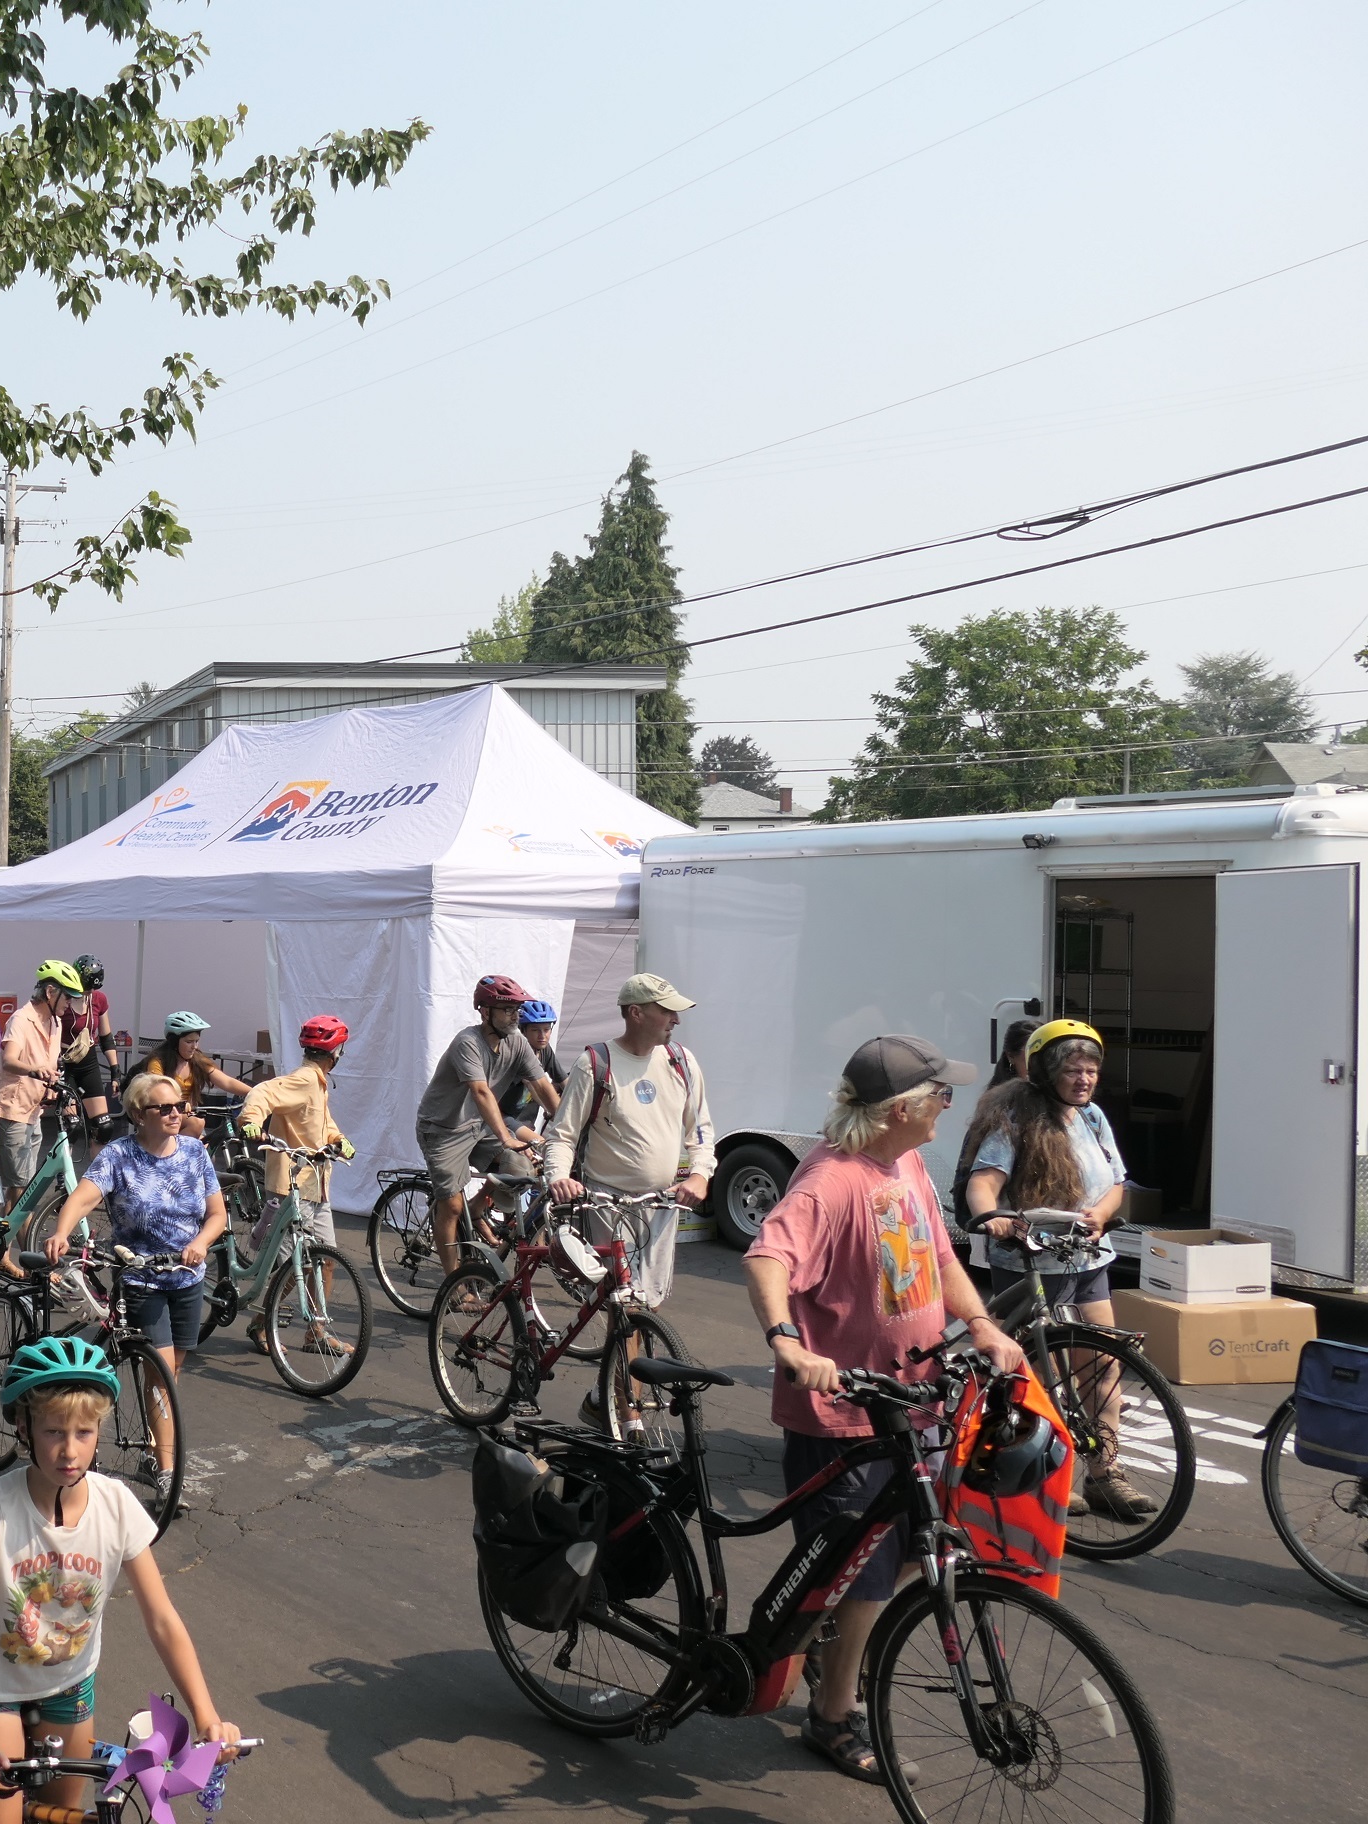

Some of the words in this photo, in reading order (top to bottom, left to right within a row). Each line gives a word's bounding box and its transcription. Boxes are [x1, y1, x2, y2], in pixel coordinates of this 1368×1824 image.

[303, 781, 439, 819] Benton
[144, 817, 212, 831] Community
[280, 814, 386, 841] County
[128, 830, 167, 841] Health
[166, 831, 211, 842] Centers
[650, 867, 681, 878] ROAD
[682, 865, 715, 876] FORCE
[1228, 1339, 1290, 1353] TentCraft
[11, 1550, 103, 1582] TROPICOOL
